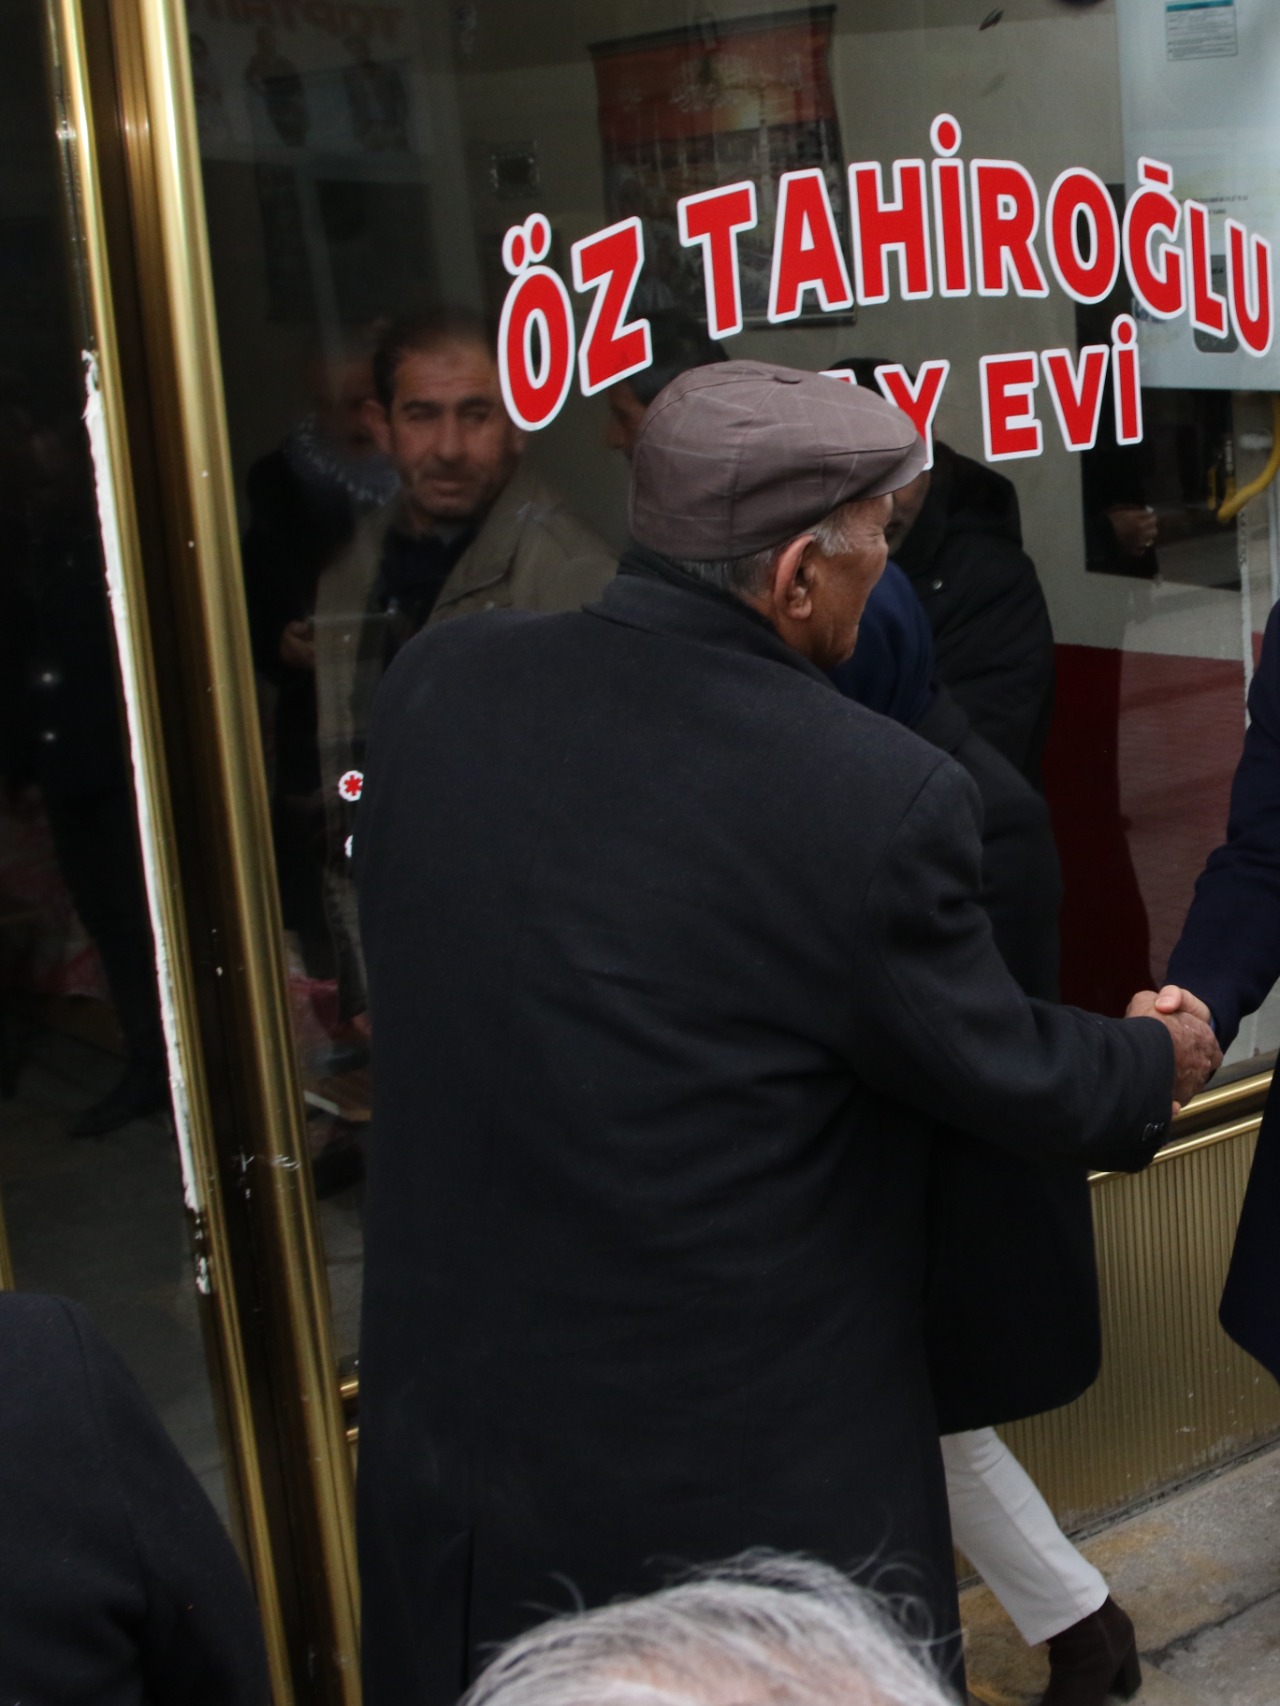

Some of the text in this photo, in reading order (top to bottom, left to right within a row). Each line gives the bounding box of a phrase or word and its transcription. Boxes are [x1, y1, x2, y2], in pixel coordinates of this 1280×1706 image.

[497, 112, 1273, 432] ÖZ TAHİROĞLU
[979, 313, 1144, 463] EVİ
